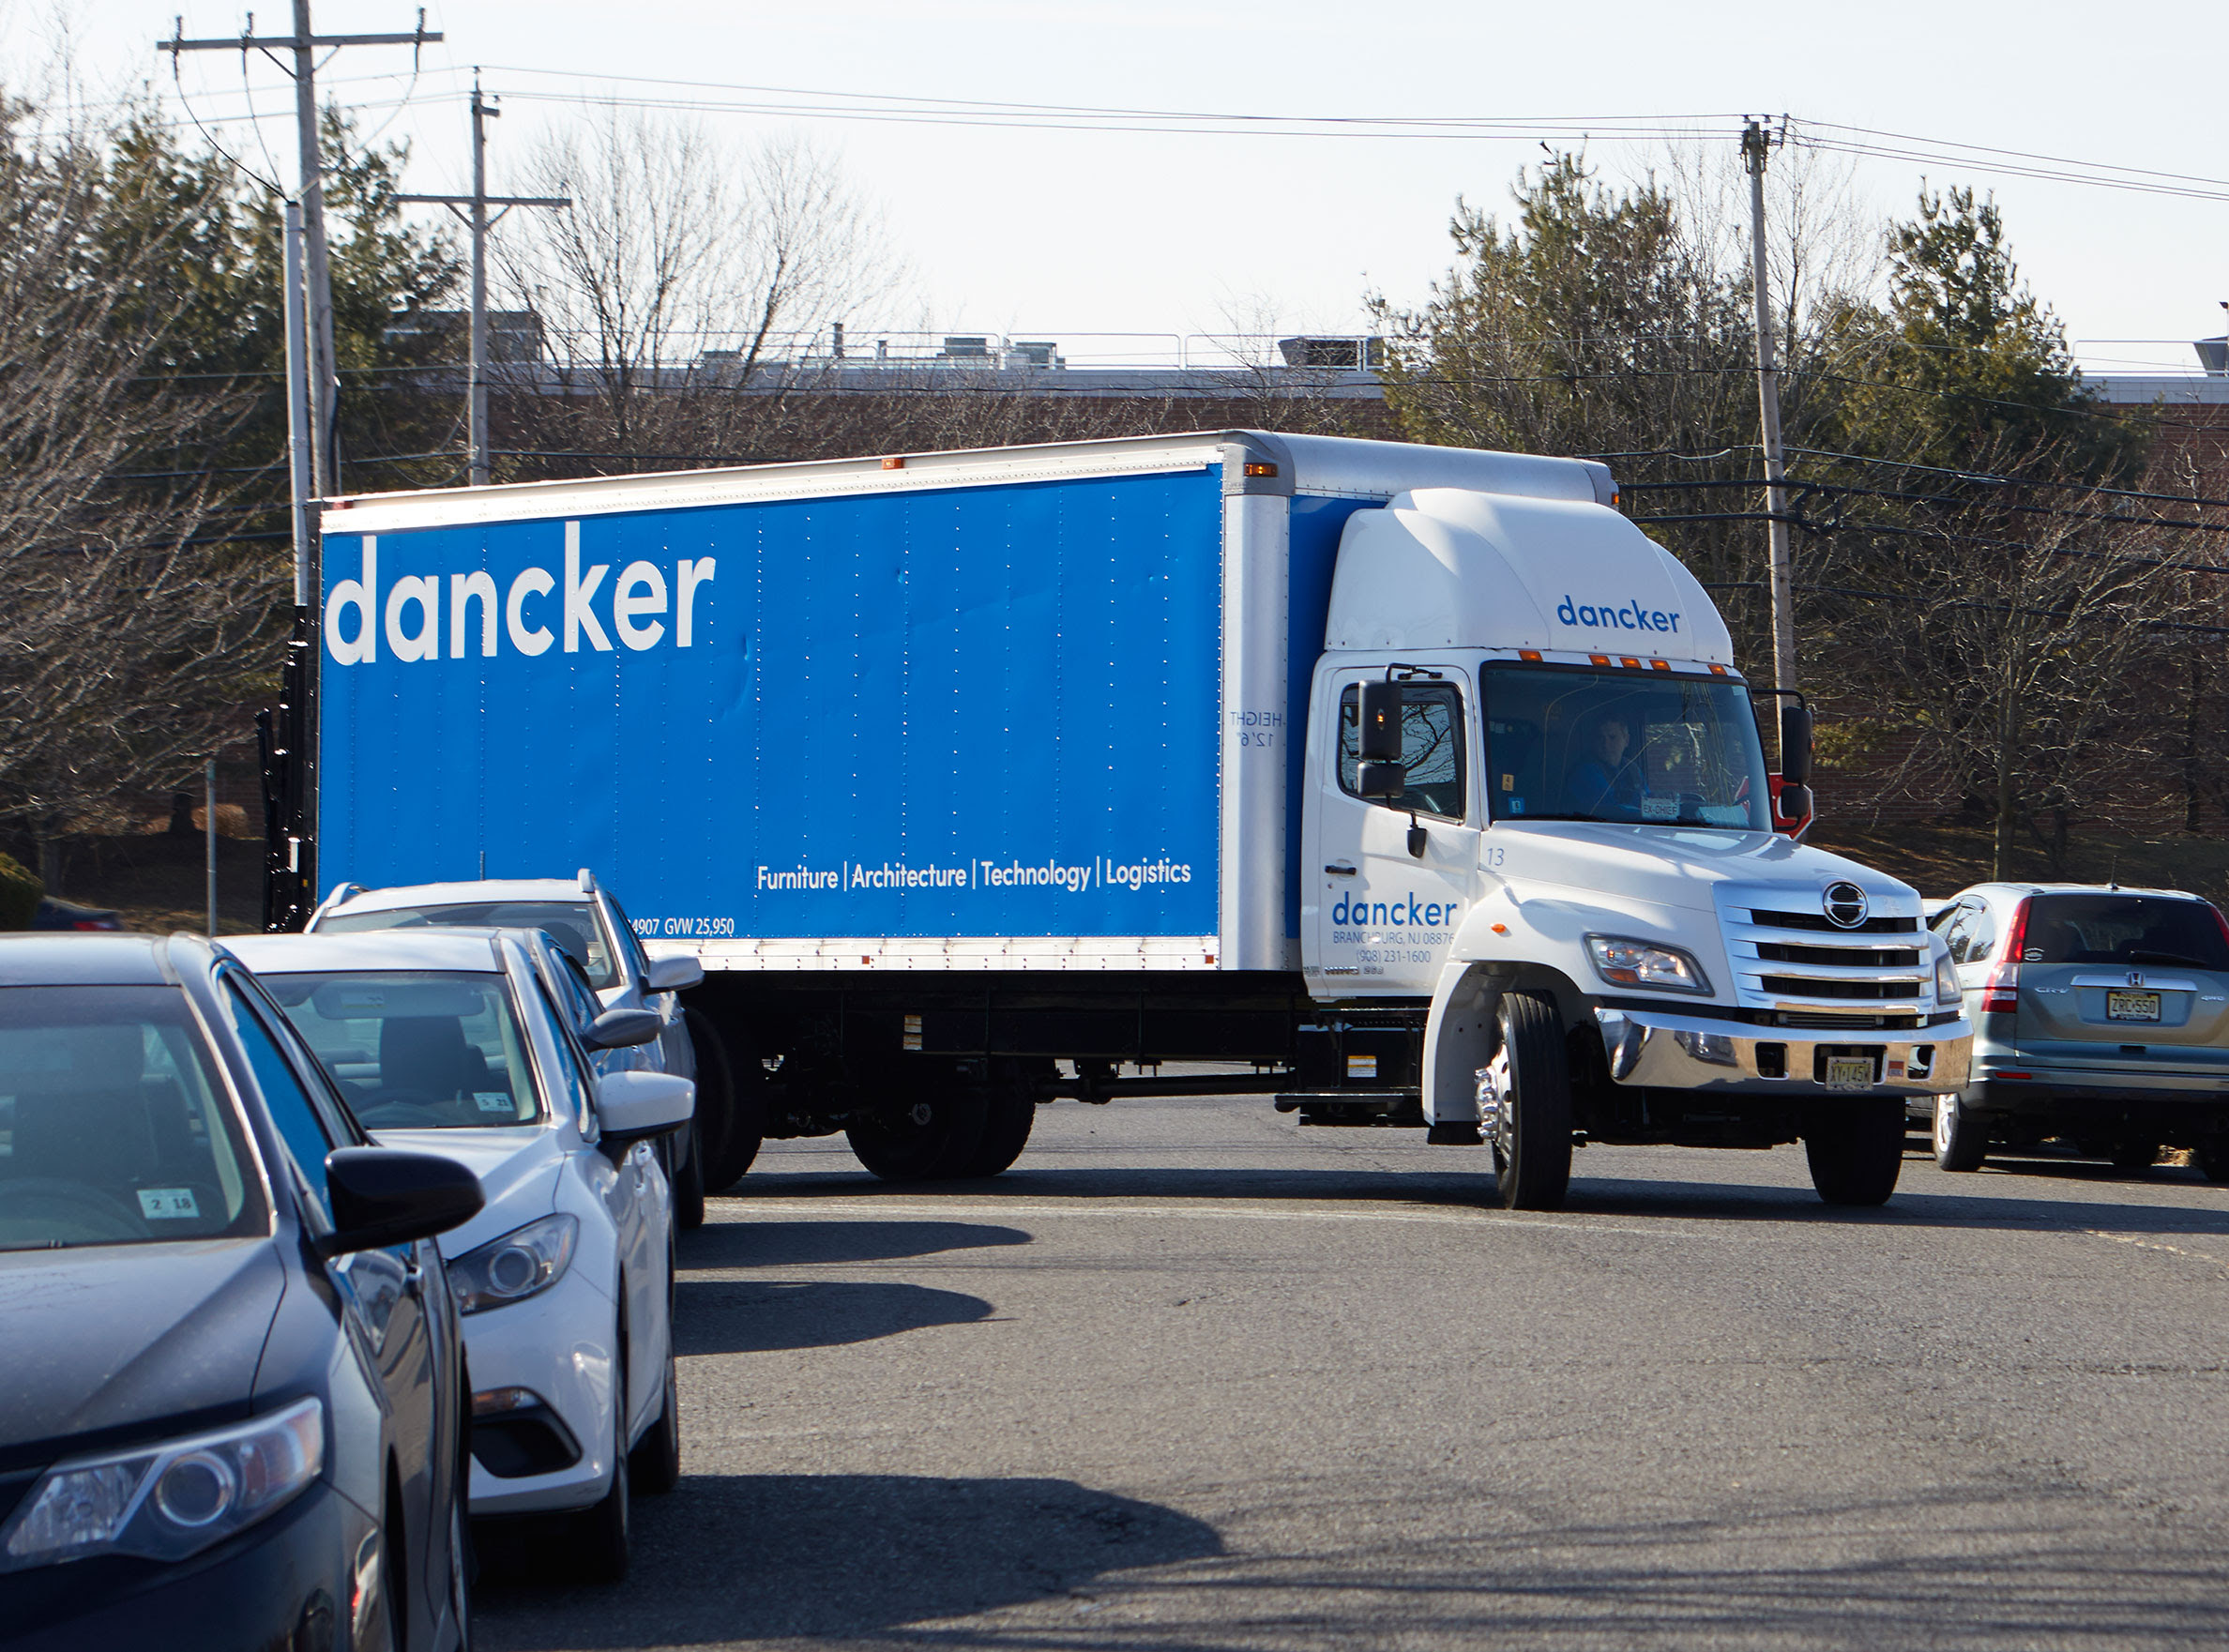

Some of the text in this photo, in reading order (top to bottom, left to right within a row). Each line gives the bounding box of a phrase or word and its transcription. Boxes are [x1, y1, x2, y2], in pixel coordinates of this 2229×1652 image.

[325, 521, 716, 666] dancker
[1557, 595, 1680, 633] dancker
[1487, 847, 1505, 866] 13
[758, 857, 1191, 892] Furniture Architecture Technology Logistics
[1332, 891, 1458, 926] dancker
[664, 917, 694, 935] GVW
[695, 917, 735, 936] 25,950
[1408, 932, 1420, 945] NJ
[1357, 949, 1431, 963] (908) 231-1600
[150, 1198, 191, 1210] 2 18
